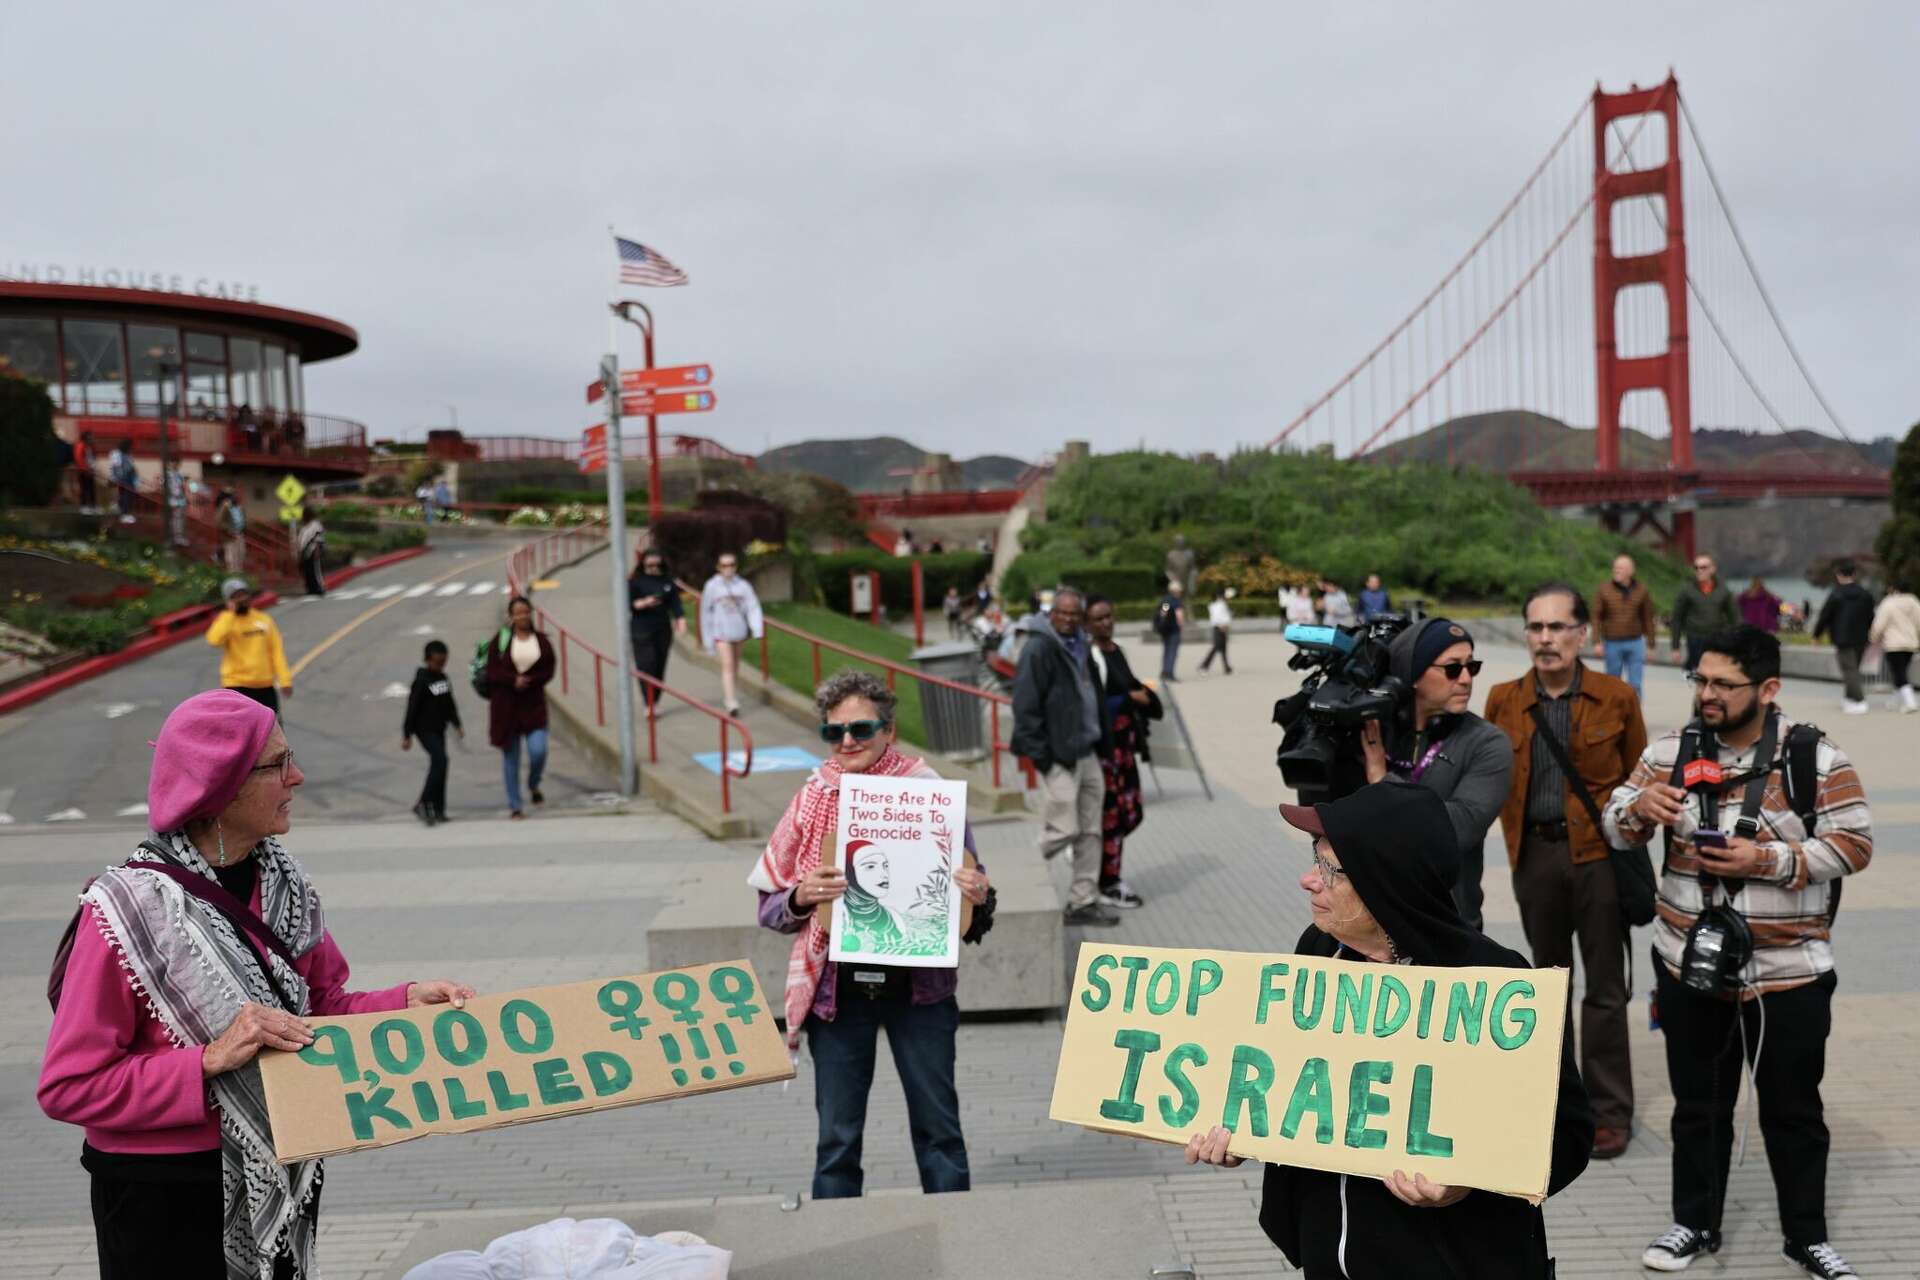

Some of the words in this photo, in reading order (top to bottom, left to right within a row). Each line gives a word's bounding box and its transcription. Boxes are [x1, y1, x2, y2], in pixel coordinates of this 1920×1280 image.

[77, 265, 182, 292] HOUSE
[850, 788, 893, 804] There
[899, 791, 925, 805] Are
[930, 792, 951, 806] No
[849, 806, 879, 821] Two
[883, 808, 923, 823] Sides
[929, 809, 945, 823] To
[848, 823, 921, 840] Genocide
[1081, 954, 1223, 1017] STOP
[1255, 962, 1537, 1051] FUNDING
[299, 998, 554, 1091] 9,000
[1099, 1028, 1453, 1158] ISRAEL
